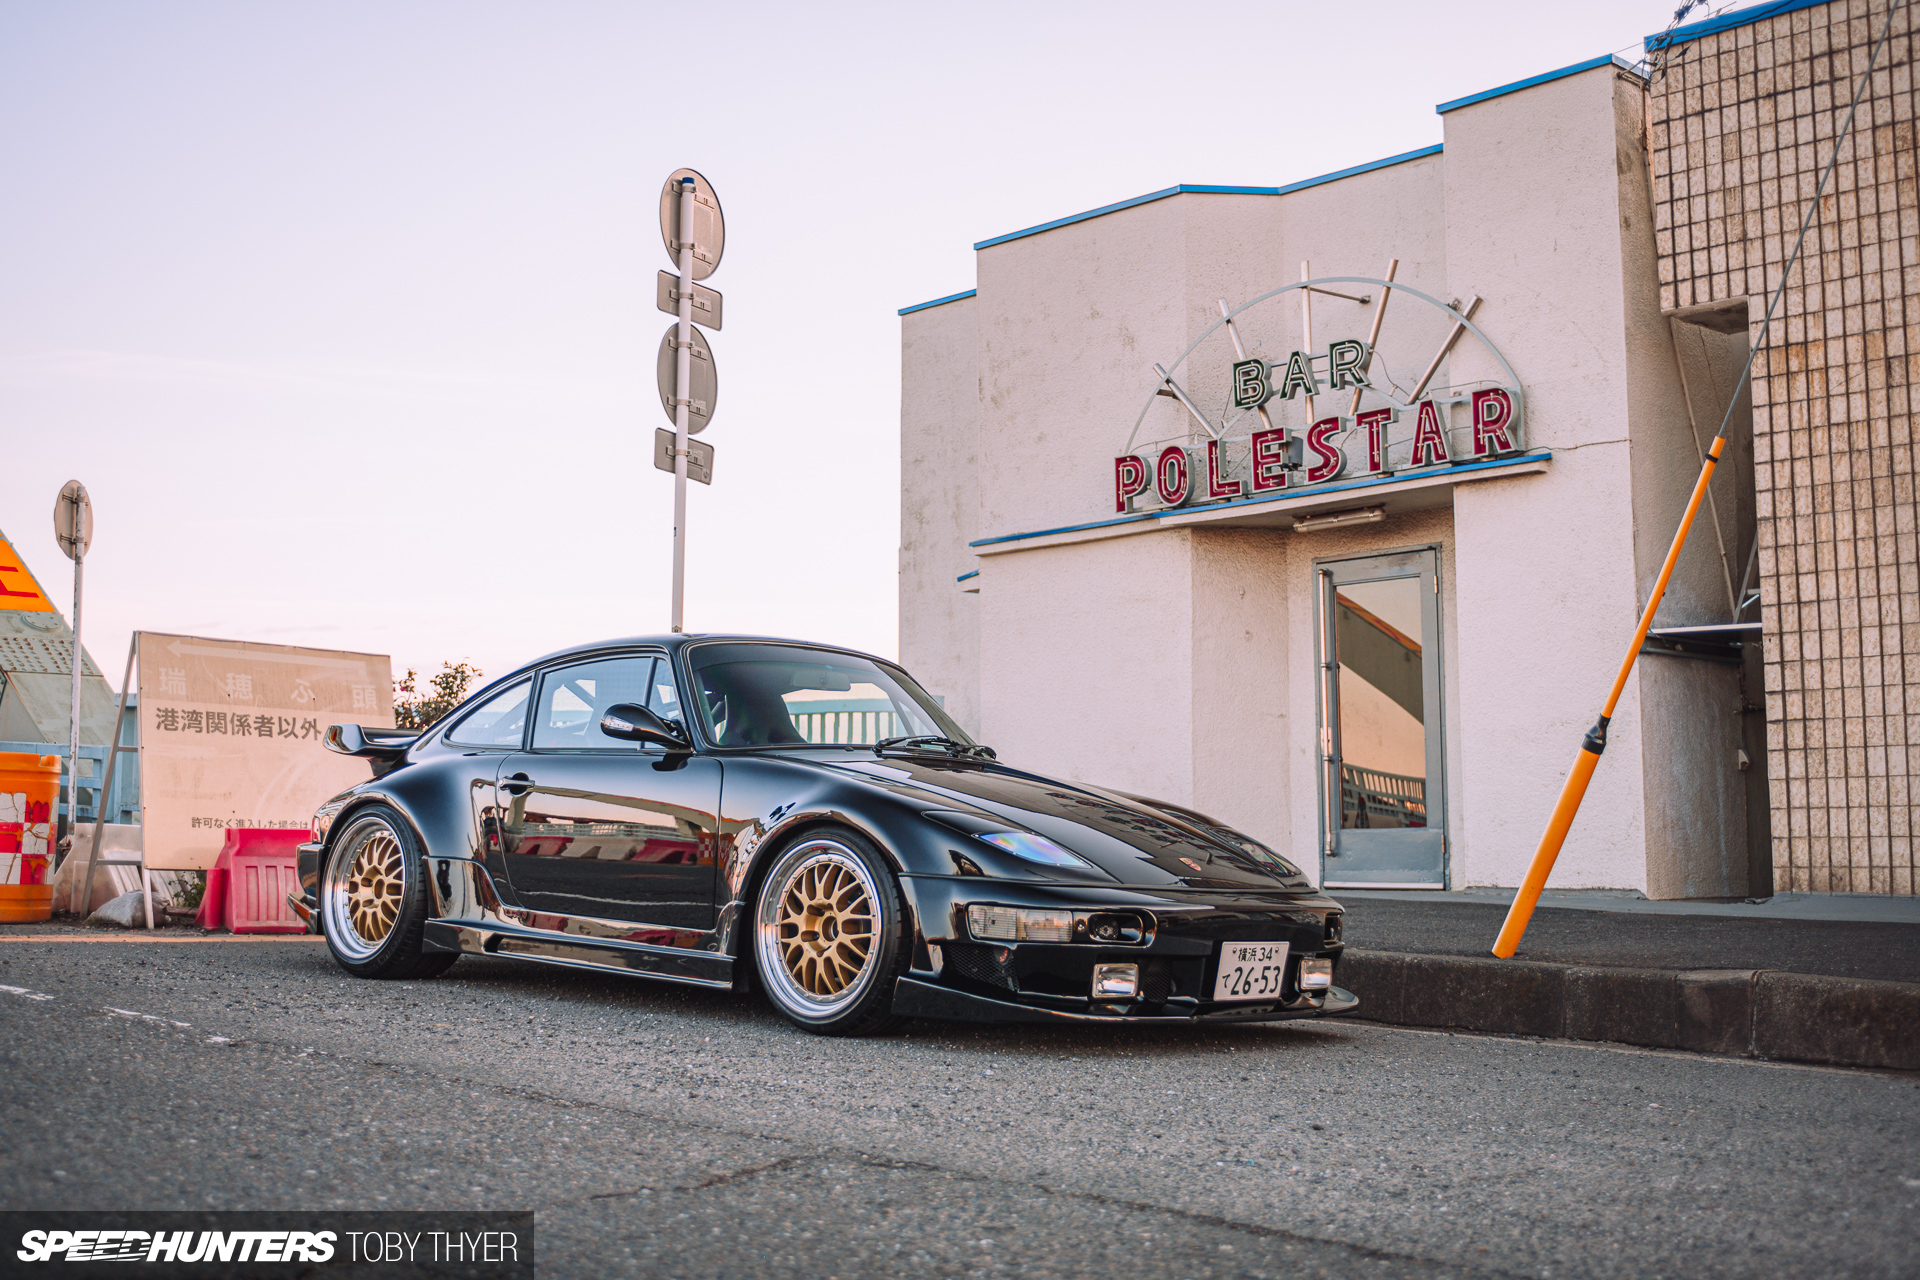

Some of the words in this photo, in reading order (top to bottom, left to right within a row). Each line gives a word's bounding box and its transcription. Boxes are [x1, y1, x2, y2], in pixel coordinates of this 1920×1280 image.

[1232, 338, 1373, 409] BAR
[1114, 386, 1518, 514] POLESTAR
[155, 707, 322, 741] 港湾関係者以外
[1238, 947, 1257, 962] 横浜
[1258, 947, 1273, 962] 34
[1230, 965, 1281, 995] 26-53
